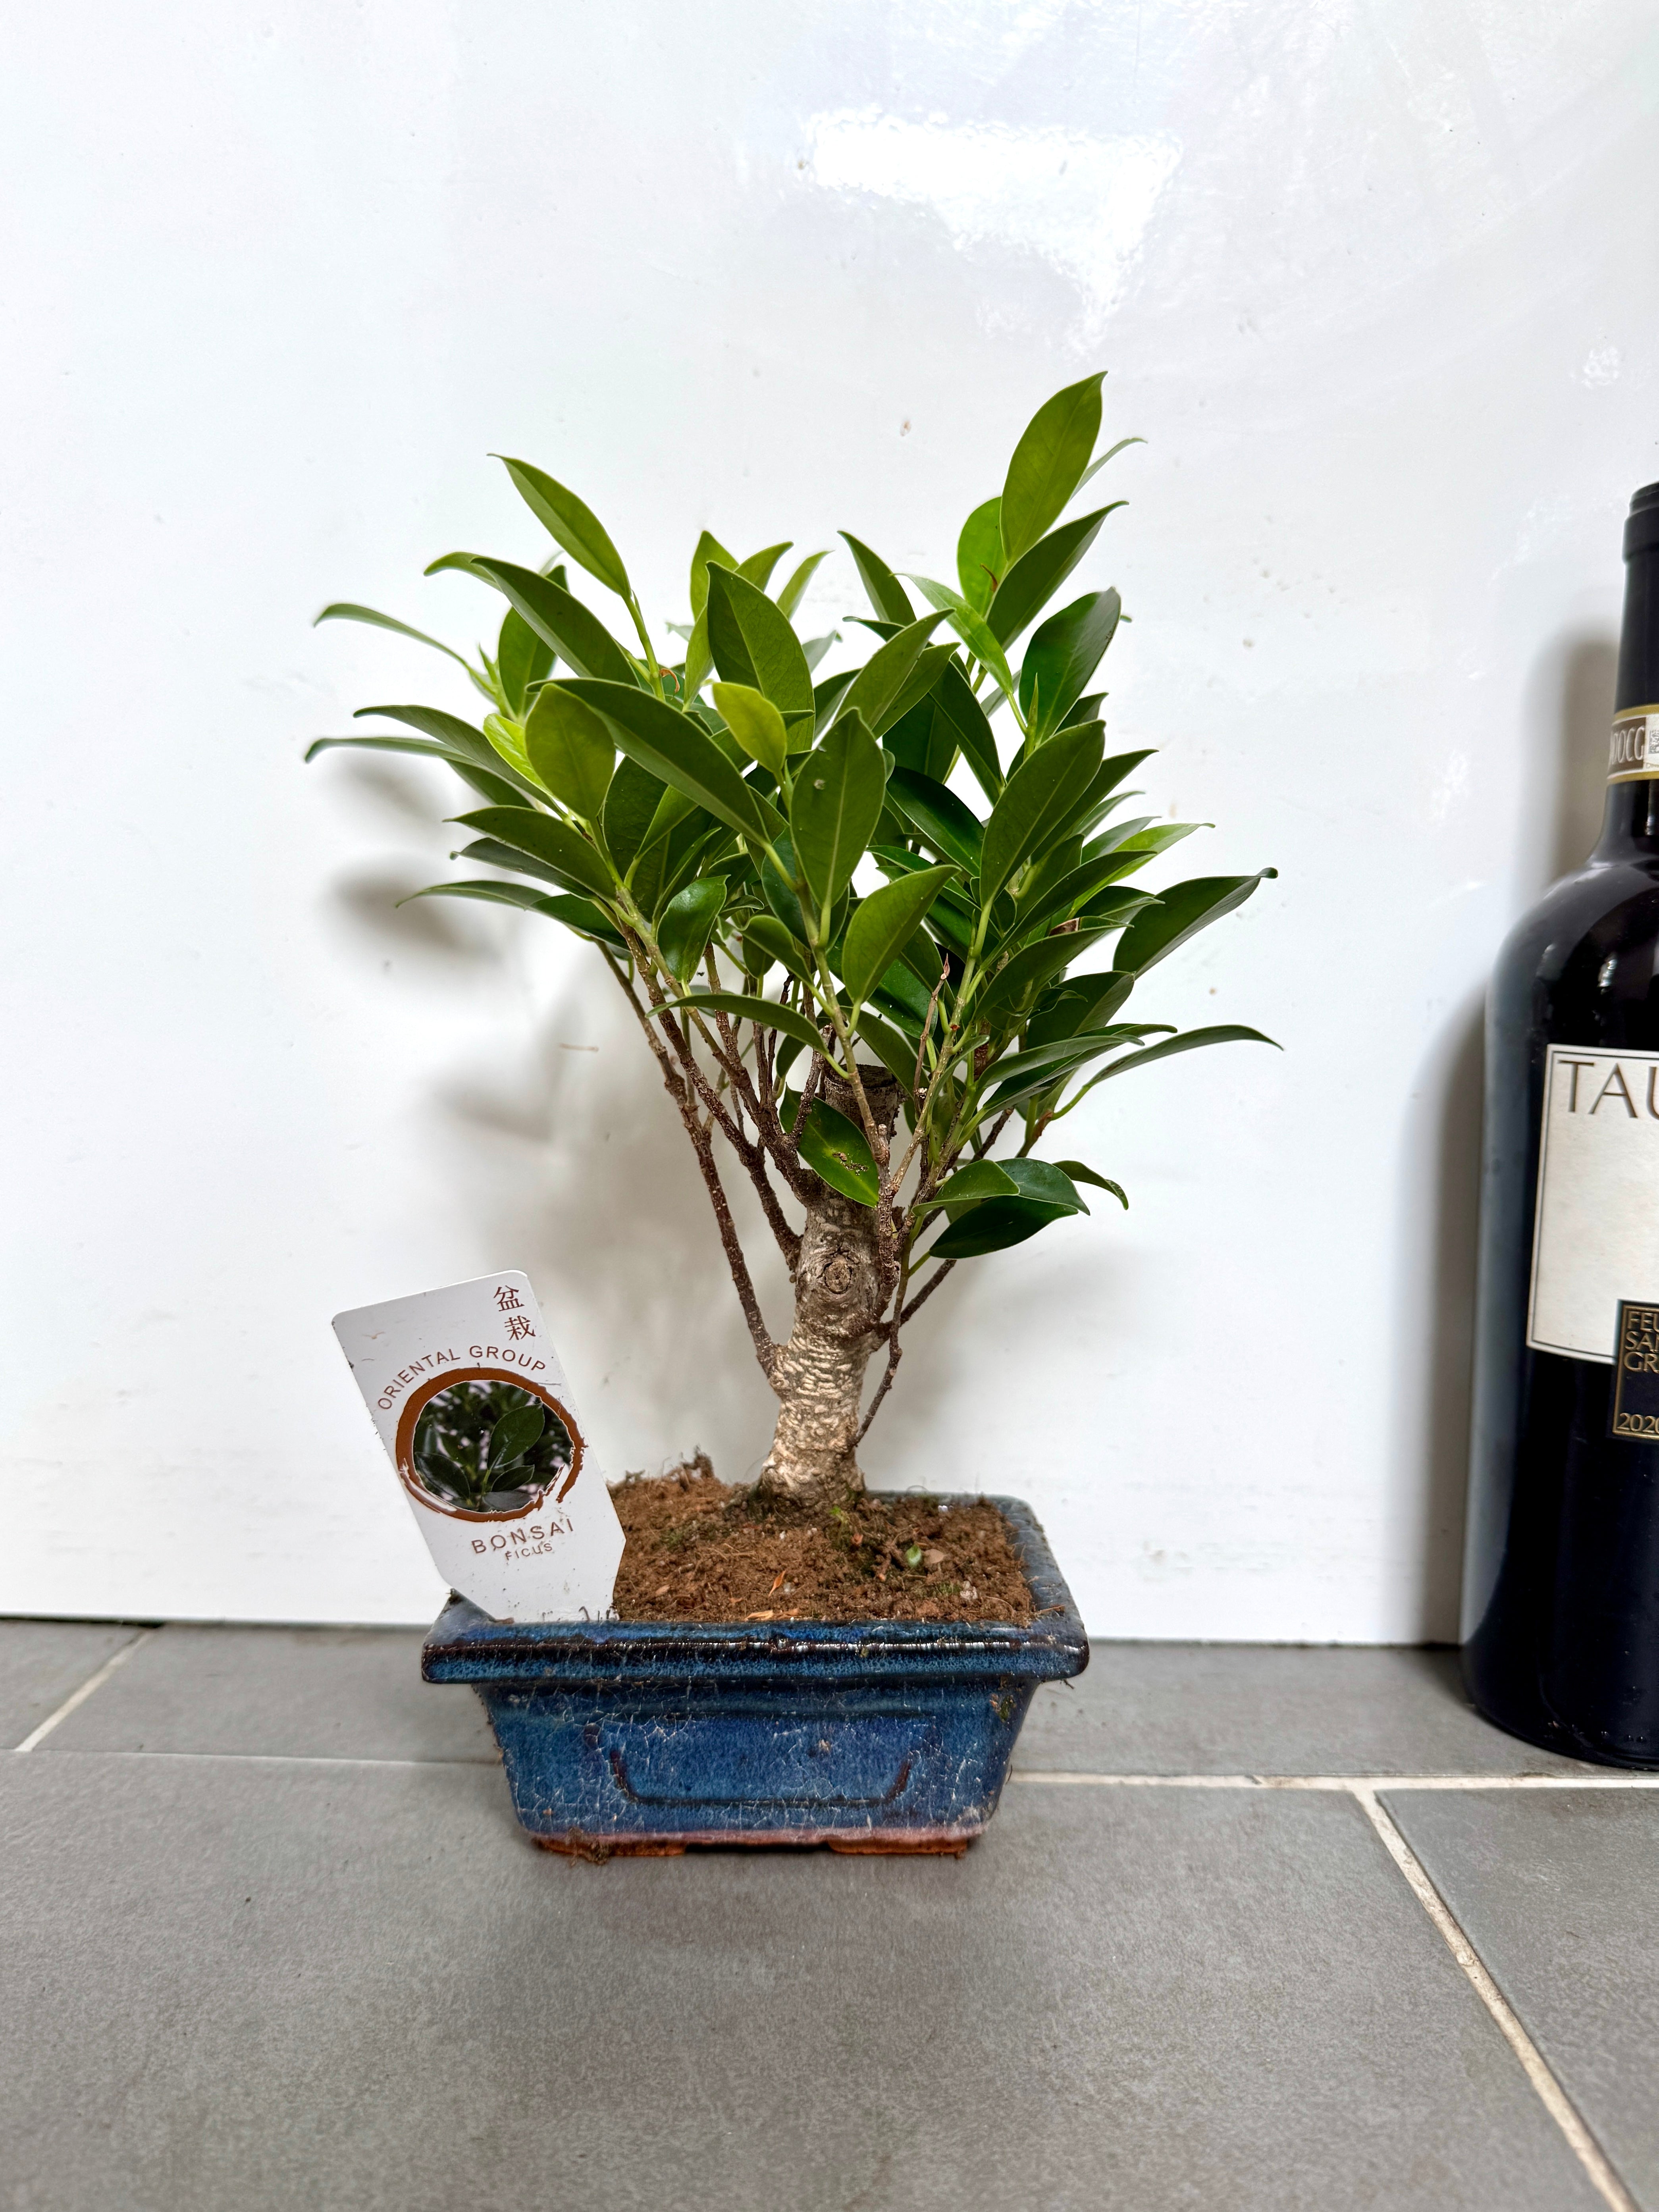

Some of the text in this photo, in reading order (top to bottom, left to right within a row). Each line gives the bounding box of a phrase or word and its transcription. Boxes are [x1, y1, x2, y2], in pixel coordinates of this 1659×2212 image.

[493, 1285, 536, 1340] 盆栽
[1625, 1331, 1659, 1353] SA
[378, 1345, 545, 1410] ORIENTAL GROUP
[471, 1518, 574, 1554] BONSAI
[505, 1543, 553, 1561] FICUS
